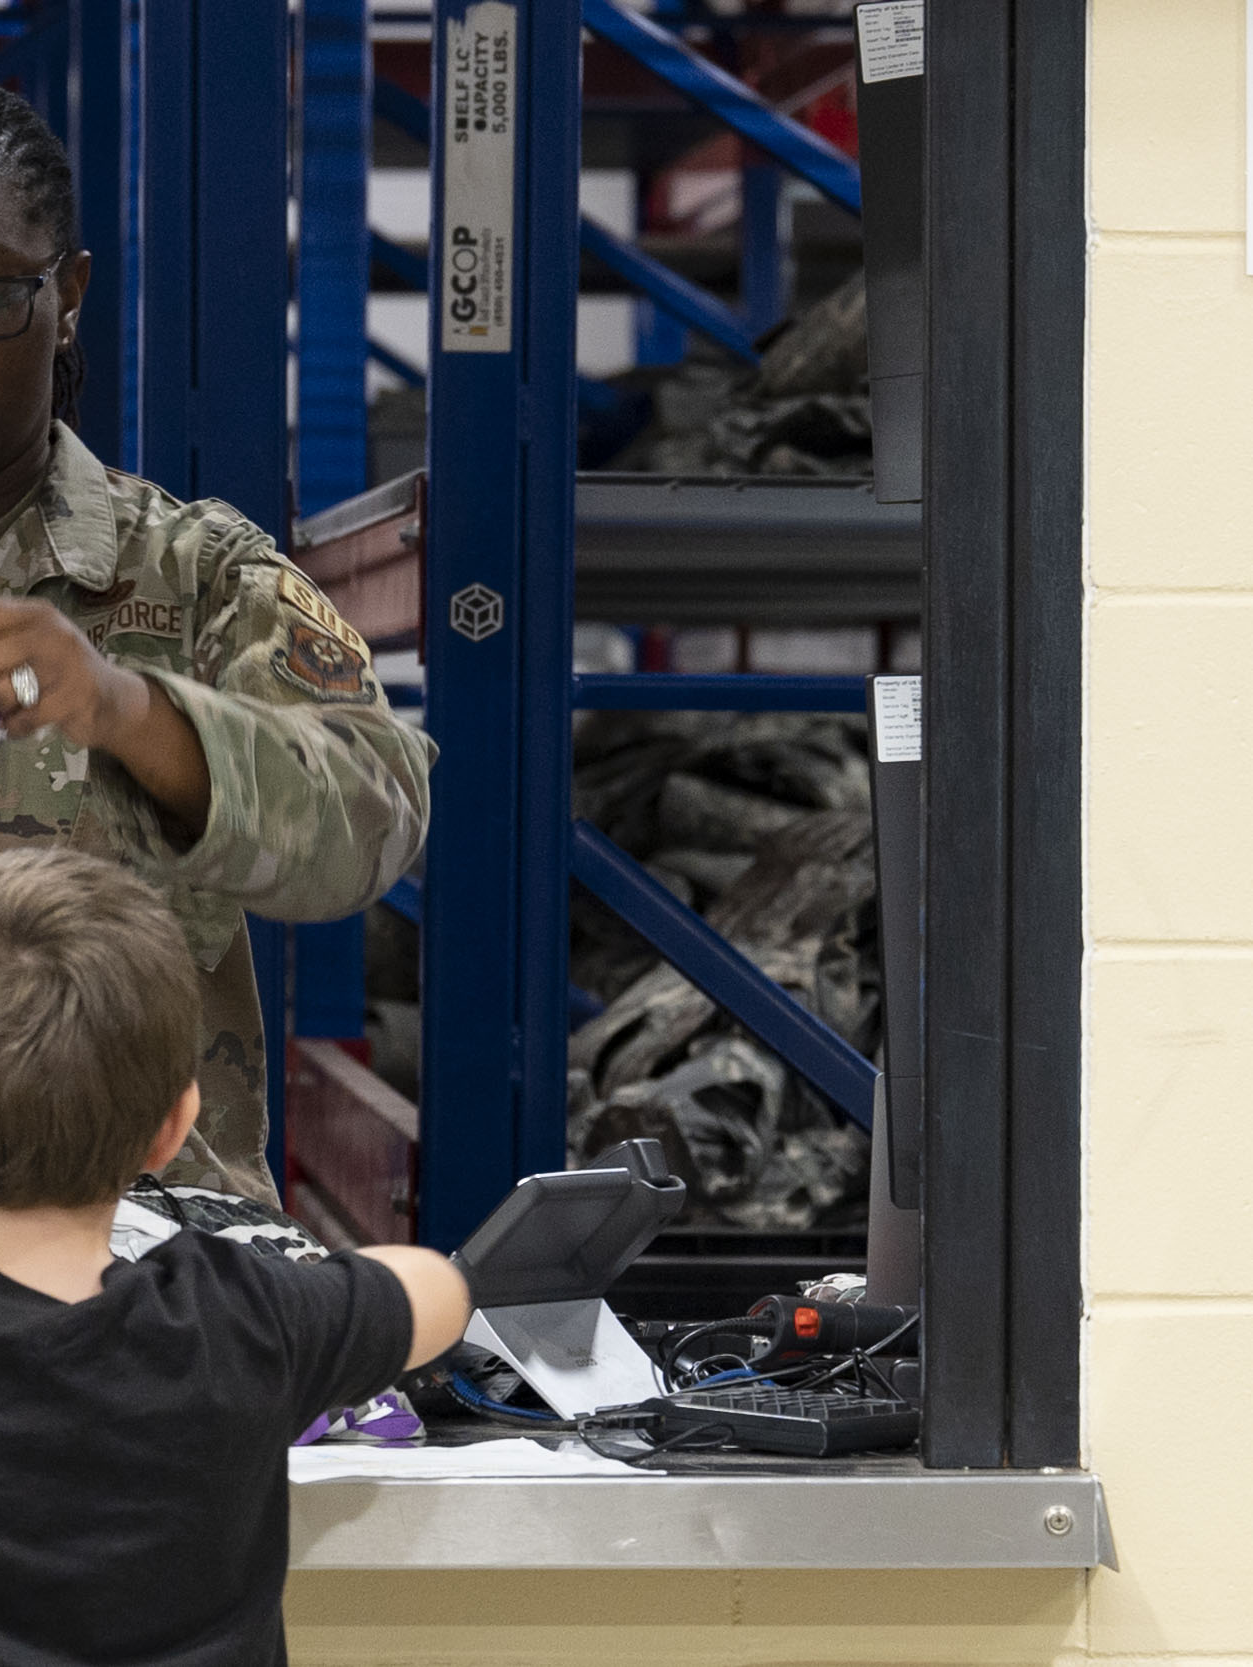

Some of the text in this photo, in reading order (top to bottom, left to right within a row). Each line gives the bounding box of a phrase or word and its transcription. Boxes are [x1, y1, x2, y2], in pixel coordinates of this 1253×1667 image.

[455, 80, 469, 143] SELF
[474, 32, 489, 131] APACITY
[492, 30, 509, 134] 5,000 LBS.
[450, 226, 478, 323] GCOP
[87, 601, 182, 650] IR FORCE
